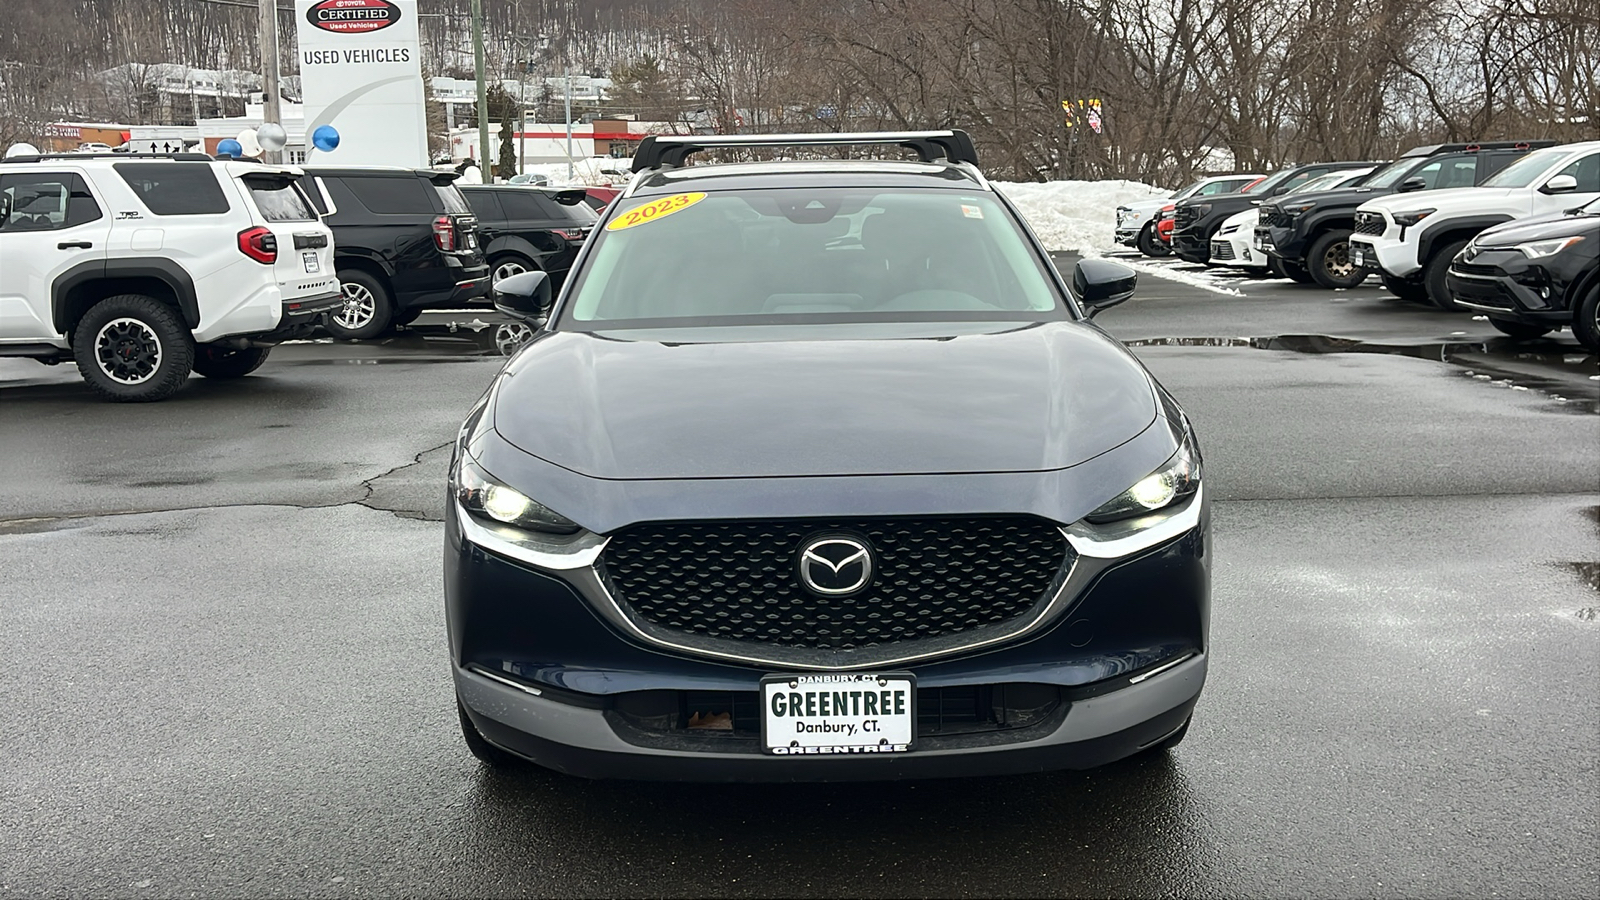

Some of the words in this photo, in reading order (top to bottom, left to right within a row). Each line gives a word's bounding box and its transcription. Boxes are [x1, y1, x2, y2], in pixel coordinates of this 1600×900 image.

[317, 9, 389, 20] CERTIFIED
[348, 21, 378, 29] Vehicles
[304, 50, 340, 65] USED
[343, 48, 410, 64] VEHICLES
[625, 195, 689, 225] 2023
[797, 675, 859, 684] DANBURY,
[861, 674, 879, 682] CT
[771, 690, 906, 717] GREENTREE
[796, 720, 858, 736] Danbury,
[862, 720, 881, 732] CT.
[772, 744, 908, 755] GREENTREE
